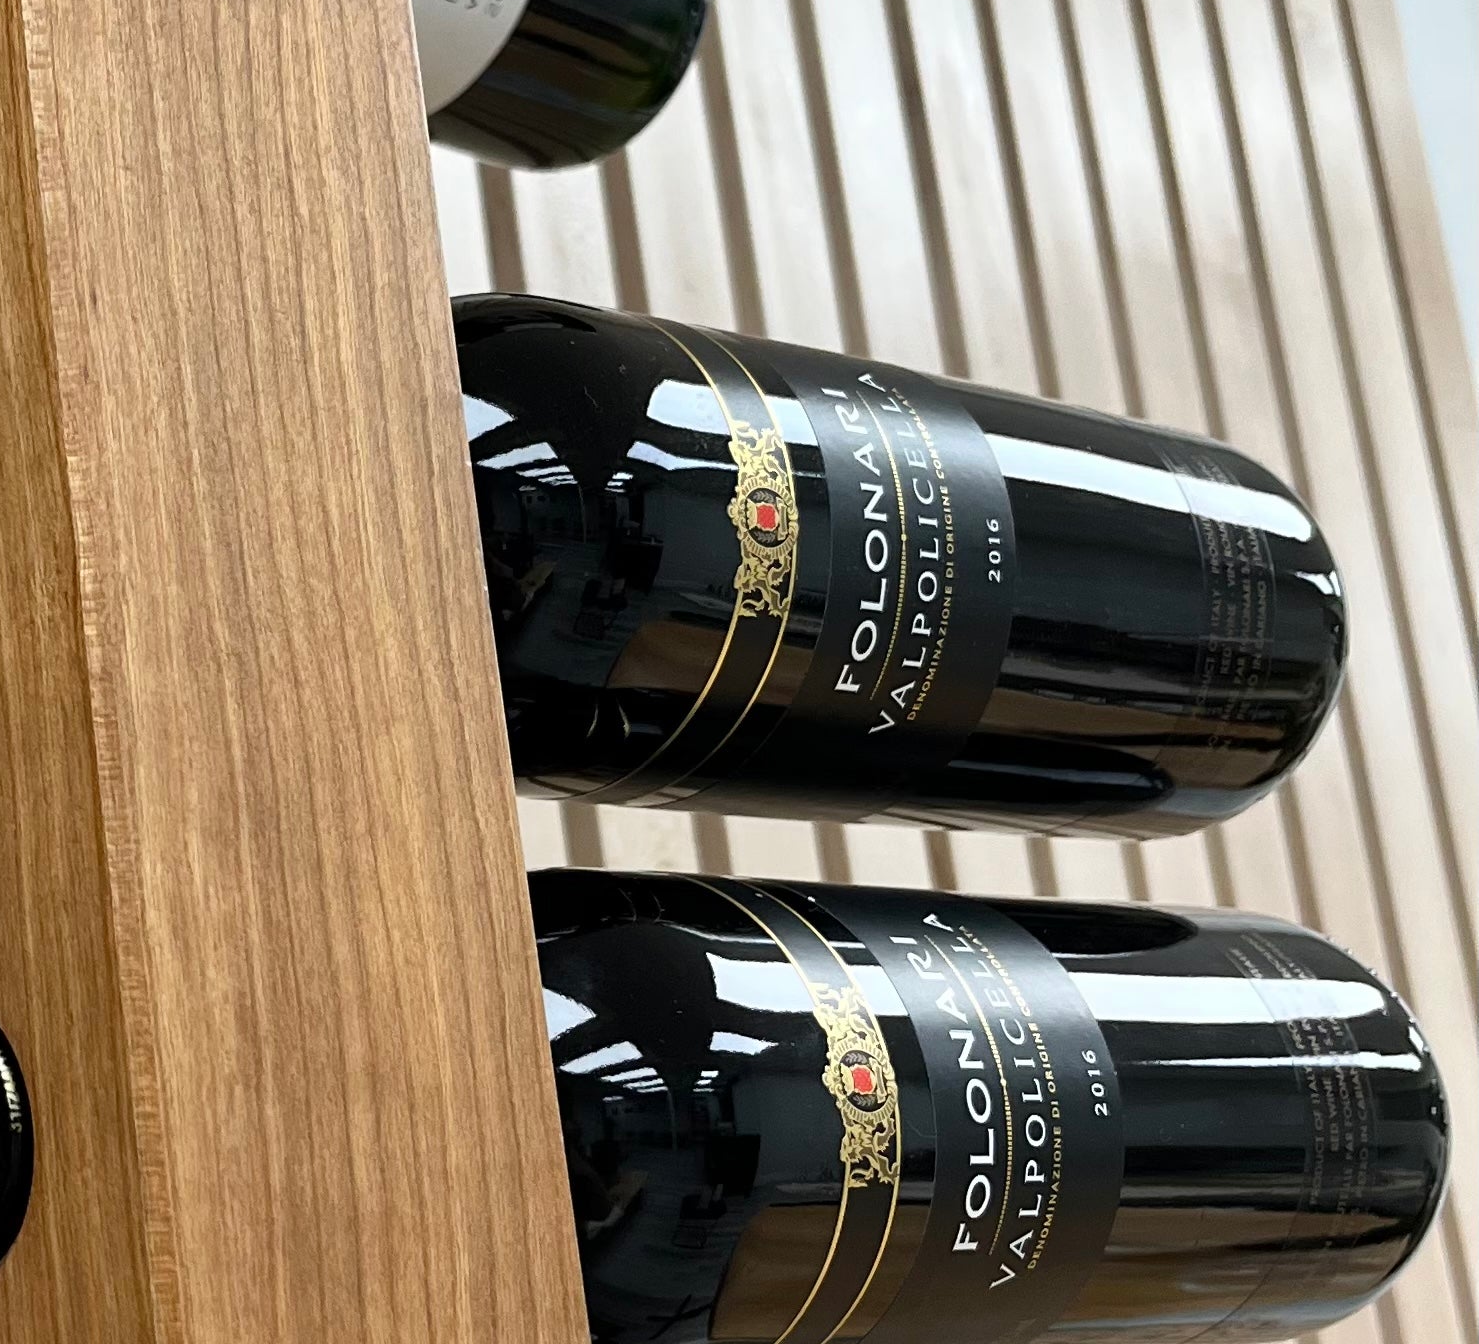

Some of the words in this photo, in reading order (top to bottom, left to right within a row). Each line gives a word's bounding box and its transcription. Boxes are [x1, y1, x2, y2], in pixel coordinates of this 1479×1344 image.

[820, 387, 889, 694] FOLONARI
[857, 372, 939, 735] VALPOLICELLA
[939, 484, 956, 555] ORIGINE
[945, 558, 955, 579] DI
[986, 518, 1001, 583] 2016
[906, 586, 954, 721] DENOMINAZIONE
[889, 935, 995, 1254] FOLONARI
[923, 913, 1048, 1290] VALPOLICELLA
[1028, 1022, 1057, 1096] ORIGINE
[1051, 1099, 1061, 1120] DI
[1081, 1049, 1110, 1117] 2016
[1027, 1126, 1064, 1269] DENOMINAZIONE
